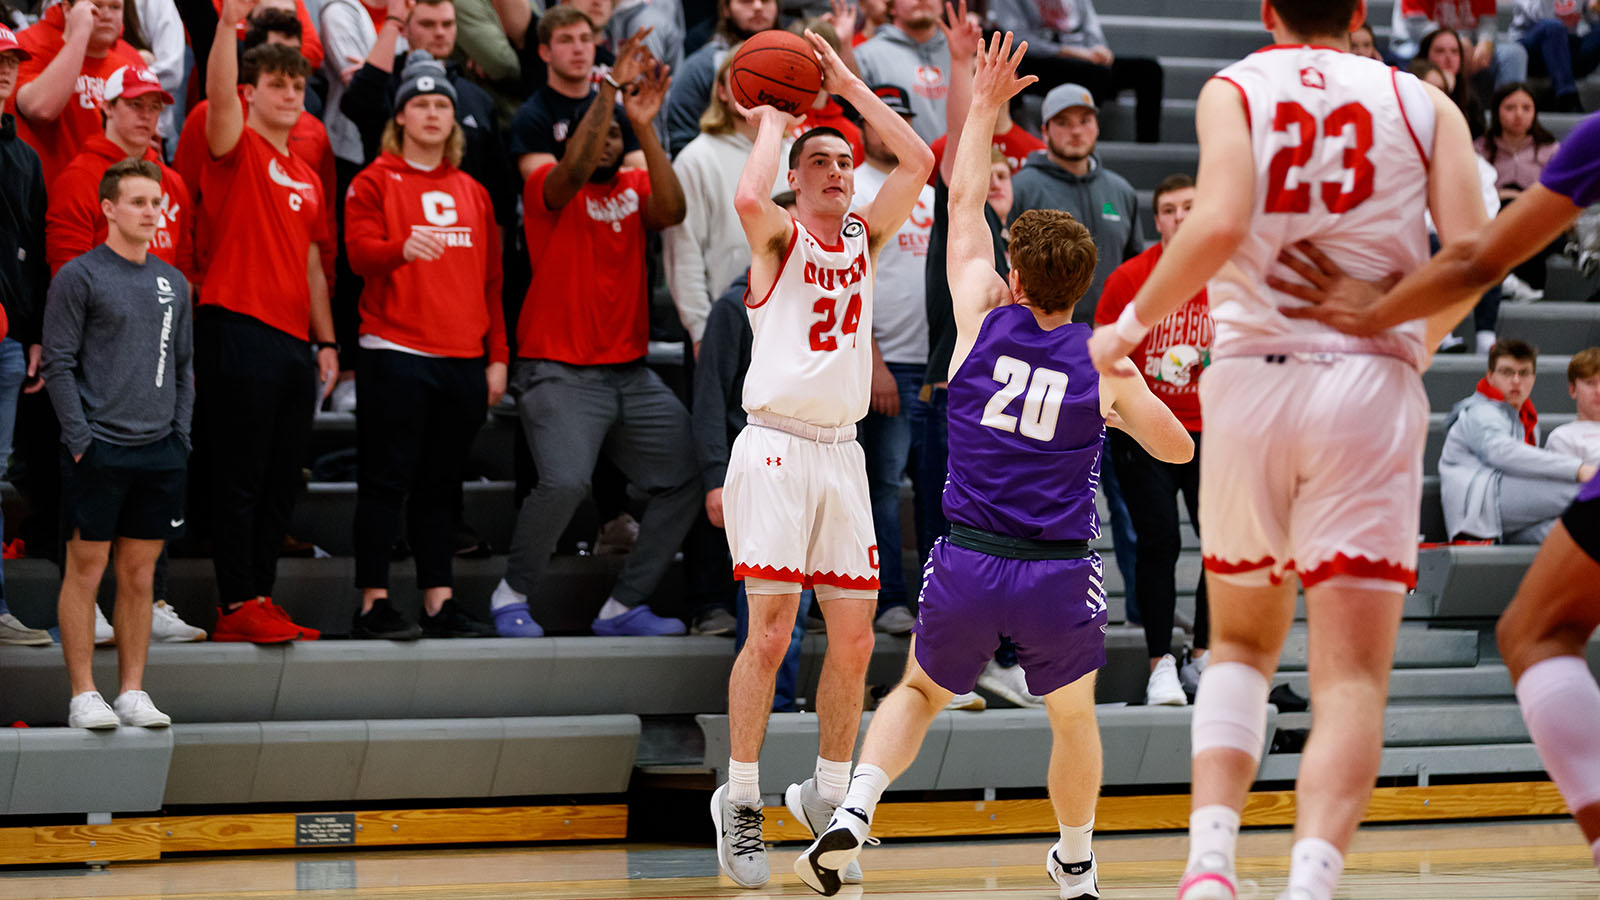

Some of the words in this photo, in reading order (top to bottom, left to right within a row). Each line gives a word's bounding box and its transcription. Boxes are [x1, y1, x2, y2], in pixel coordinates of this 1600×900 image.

[1264, 101, 1376, 214] 23
[289, 192, 303, 212] C
[421, 190, 458, 227] C
[155, 304, 173, 388] CENTRAL
[808, 292, 863, 353] 24
[980, 354, 1069, 442] 20
